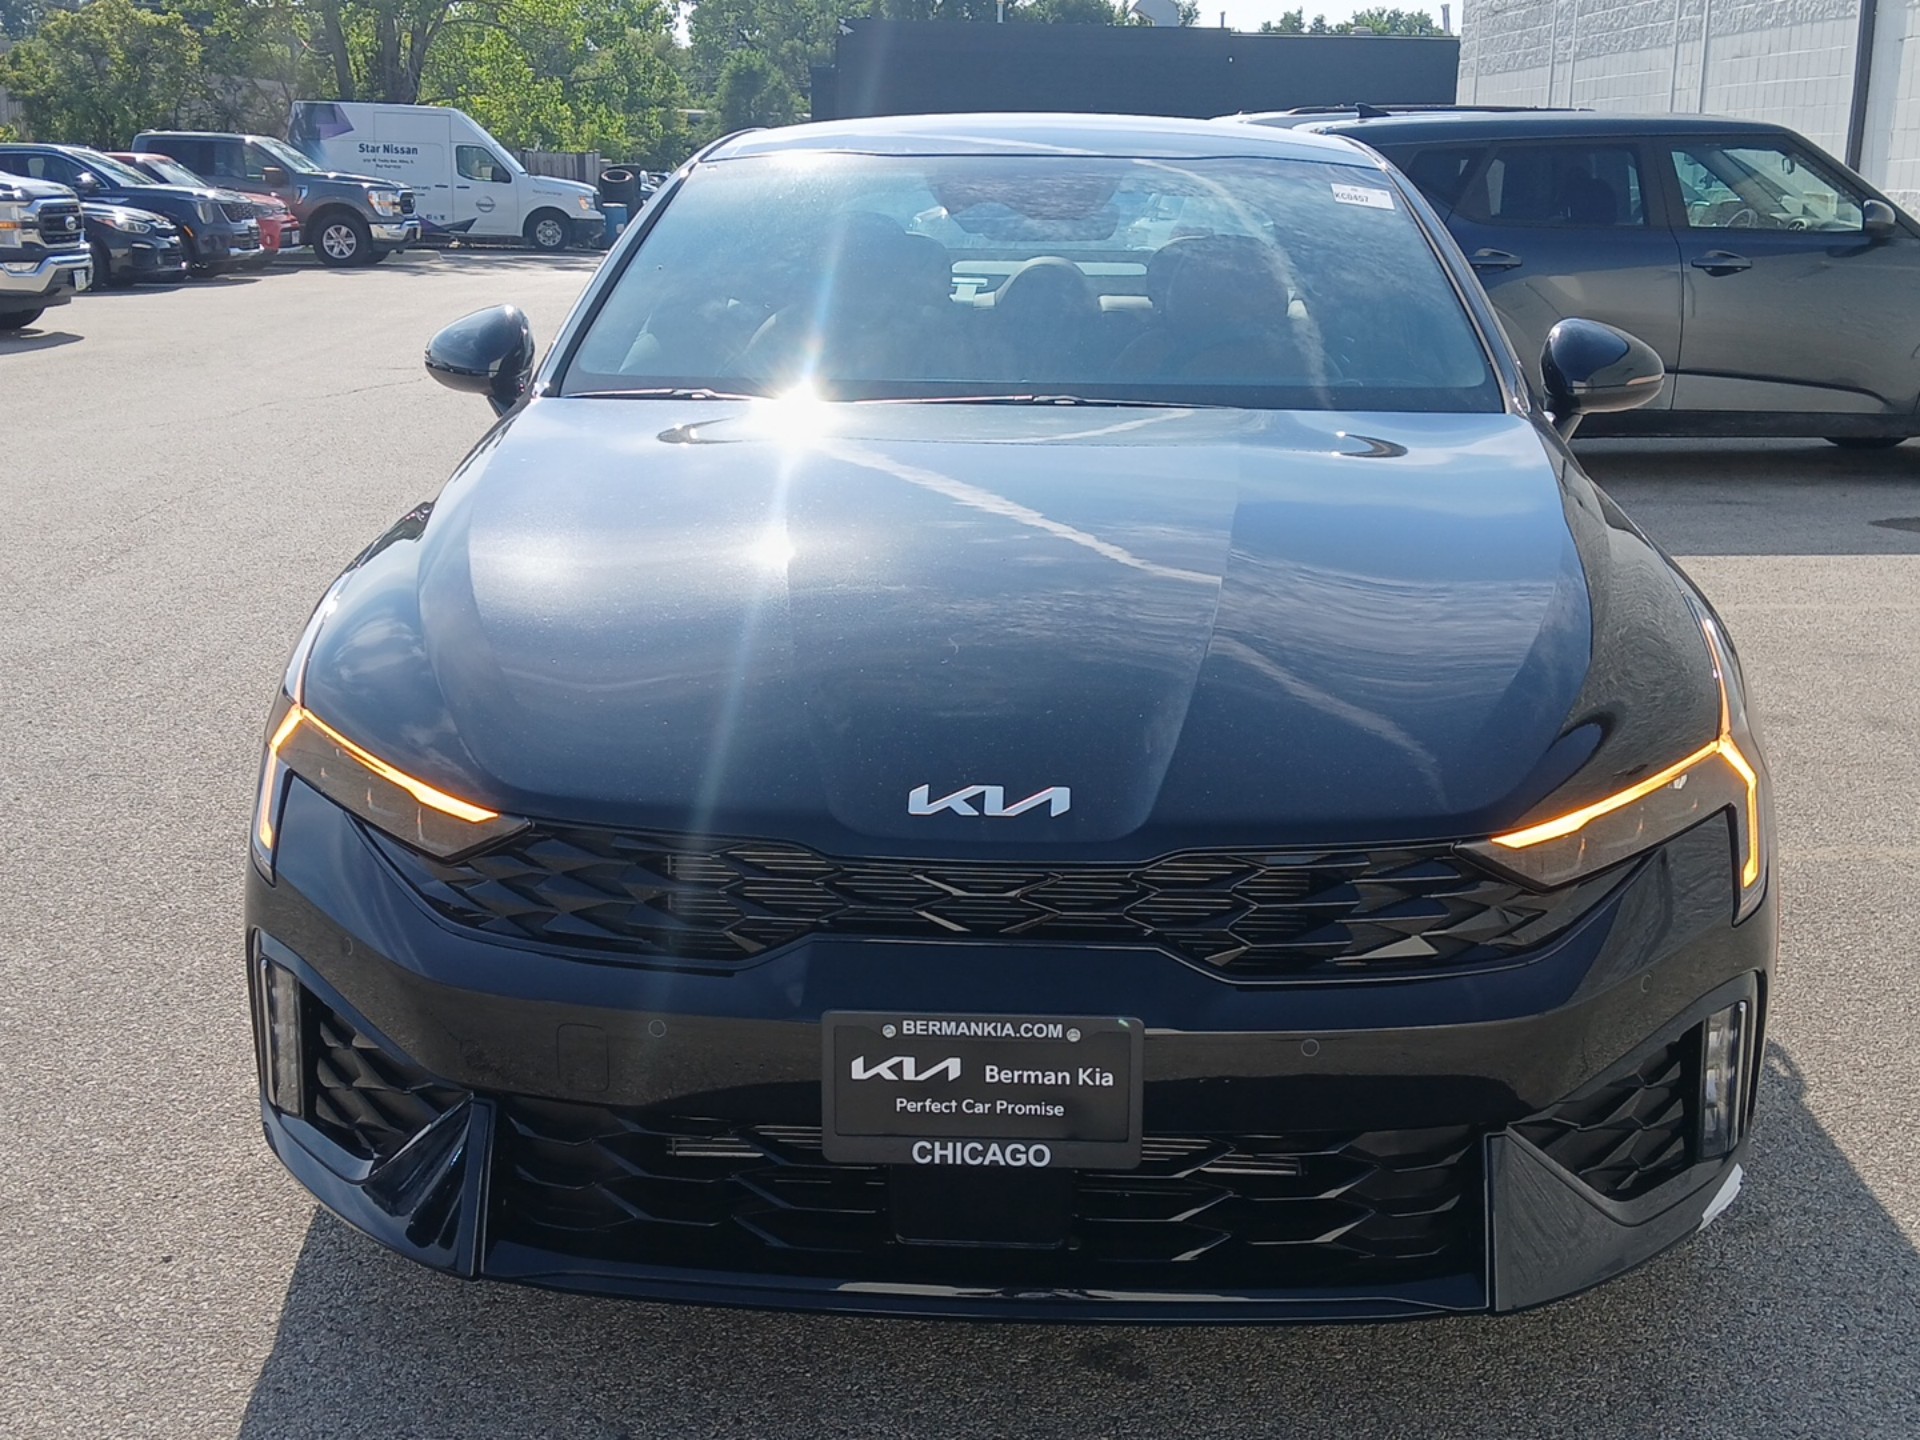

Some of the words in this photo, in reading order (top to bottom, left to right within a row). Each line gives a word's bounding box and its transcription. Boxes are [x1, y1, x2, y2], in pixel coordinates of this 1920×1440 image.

[358, 143, 381, 154] Star
[382, 144, 418, 155] Nissan
[908, 783, 1071, 817] KIA
[902, 1020, 1063, 1039] BERMANKIA.COM
[851, 1055, 961, 1082] KIA
[984, 1064, 1071, 1085] Berman
[1077, 1067, 1115, 1087] Kia
[895, 1097, 958, 1114] Perfect
[961, 1098, 992, 1115] Car
[995, 1100, 1065, 1117] Promise
[911, 1140, 1051, 1168] CHICAGO
